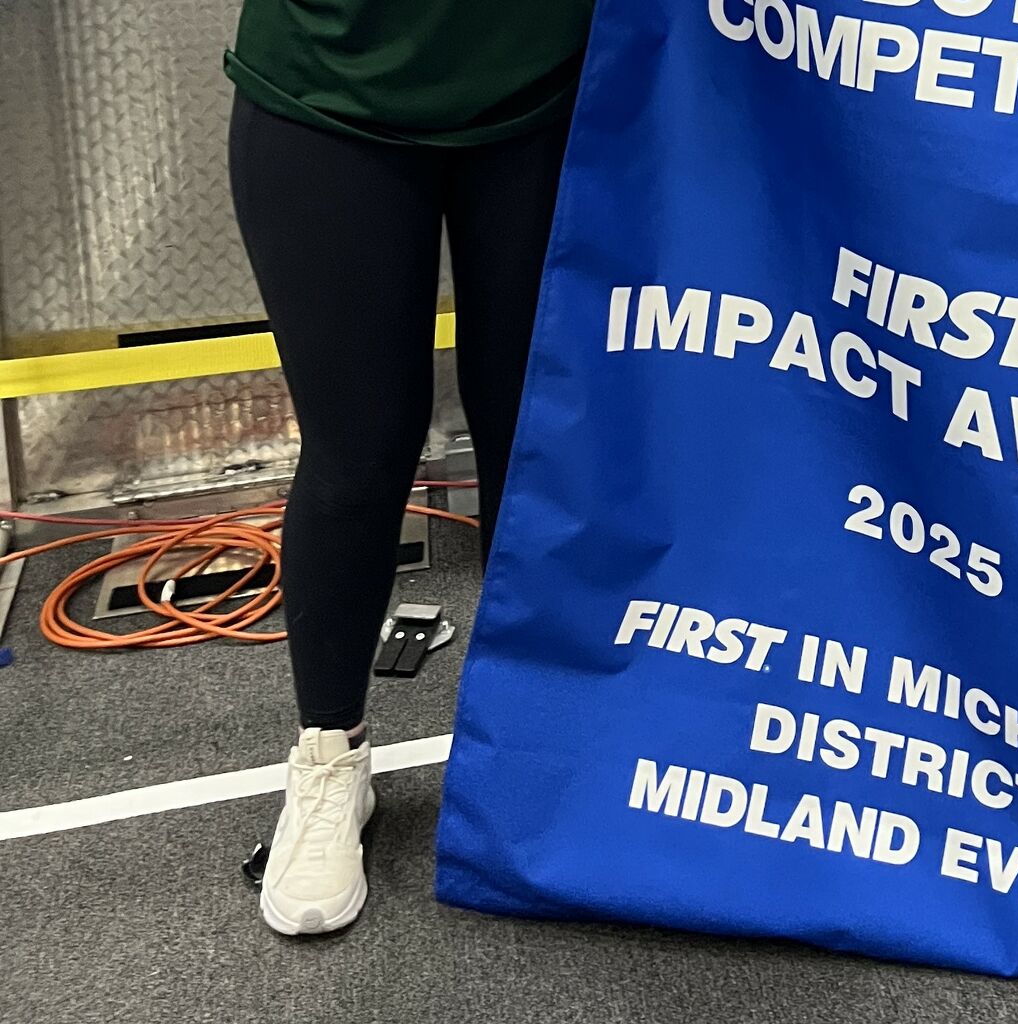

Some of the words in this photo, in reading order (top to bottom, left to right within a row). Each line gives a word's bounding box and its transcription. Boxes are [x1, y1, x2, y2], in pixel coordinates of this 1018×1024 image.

[606, 285, 922, 421] IMPACT
[843, 484, 1004, 598] 2025
[796, 634, 868, 694] IN
[628, 758, 921, 866] MIDLAND
